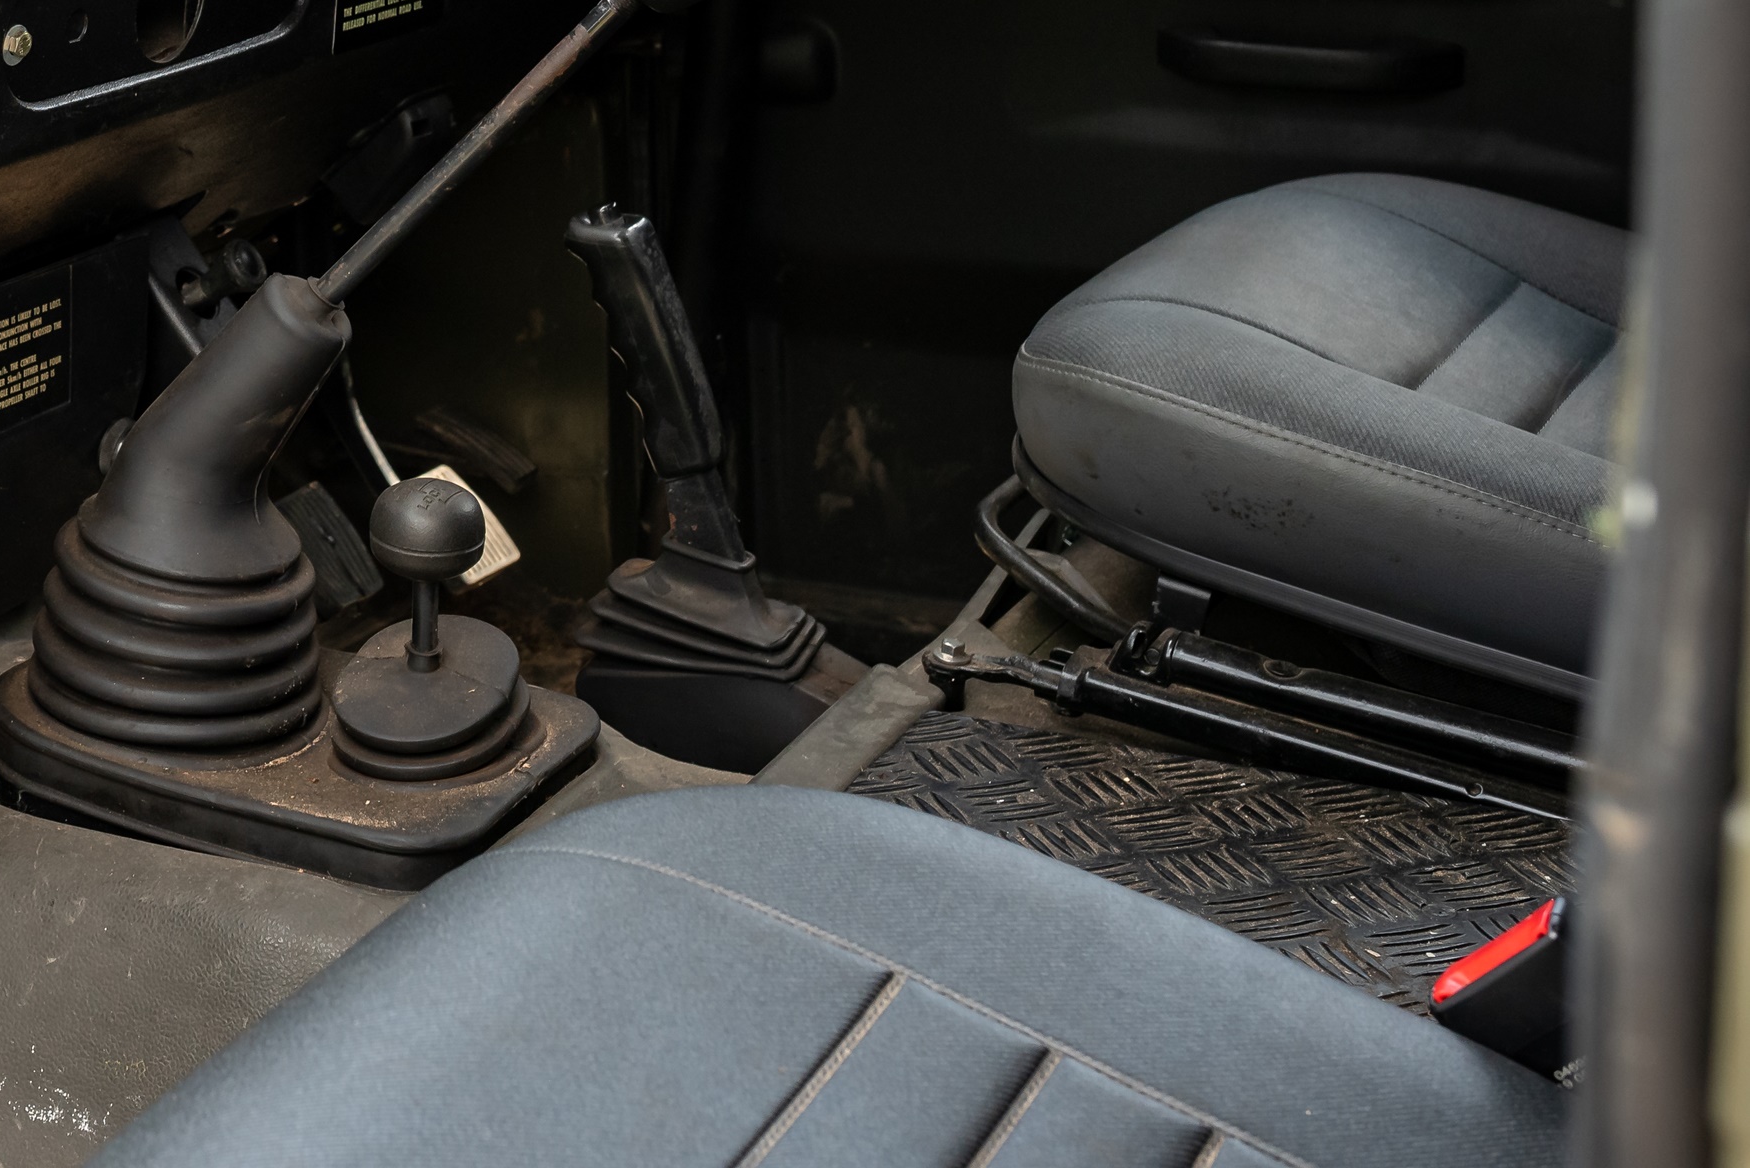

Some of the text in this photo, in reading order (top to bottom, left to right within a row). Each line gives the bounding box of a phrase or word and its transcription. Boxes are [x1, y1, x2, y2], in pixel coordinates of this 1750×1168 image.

[11, 316, 16, 325] IS
[18, 310, 31, 323] LIKELY
[34, 306, 40, 316] TO
[42, 303, 47, 313] BE
[30, 317, 42, 329] WITH
[9, 337, 18, 349] HAS
[20, 332, 31, 345] BEEN
[32, 324, 52, 340] CROSSED
[10, 361, 18, 372] THE
[20, 354, 36, 368] CENTRE
[23, 364, 38, 378] EITHER
[50, 355, 61, 368] FOUR
[10, 383, 21, 395] AXLE
[23, 375, 39, 390] ROLLER
[41, 371, 49, 382] RIG
[50, 369, 55, 378] IS
[0, 393, 23, 411] PROPELLER
[25, 387, 38, 400] SHAFT
[40, 383, 46, 394] TO
